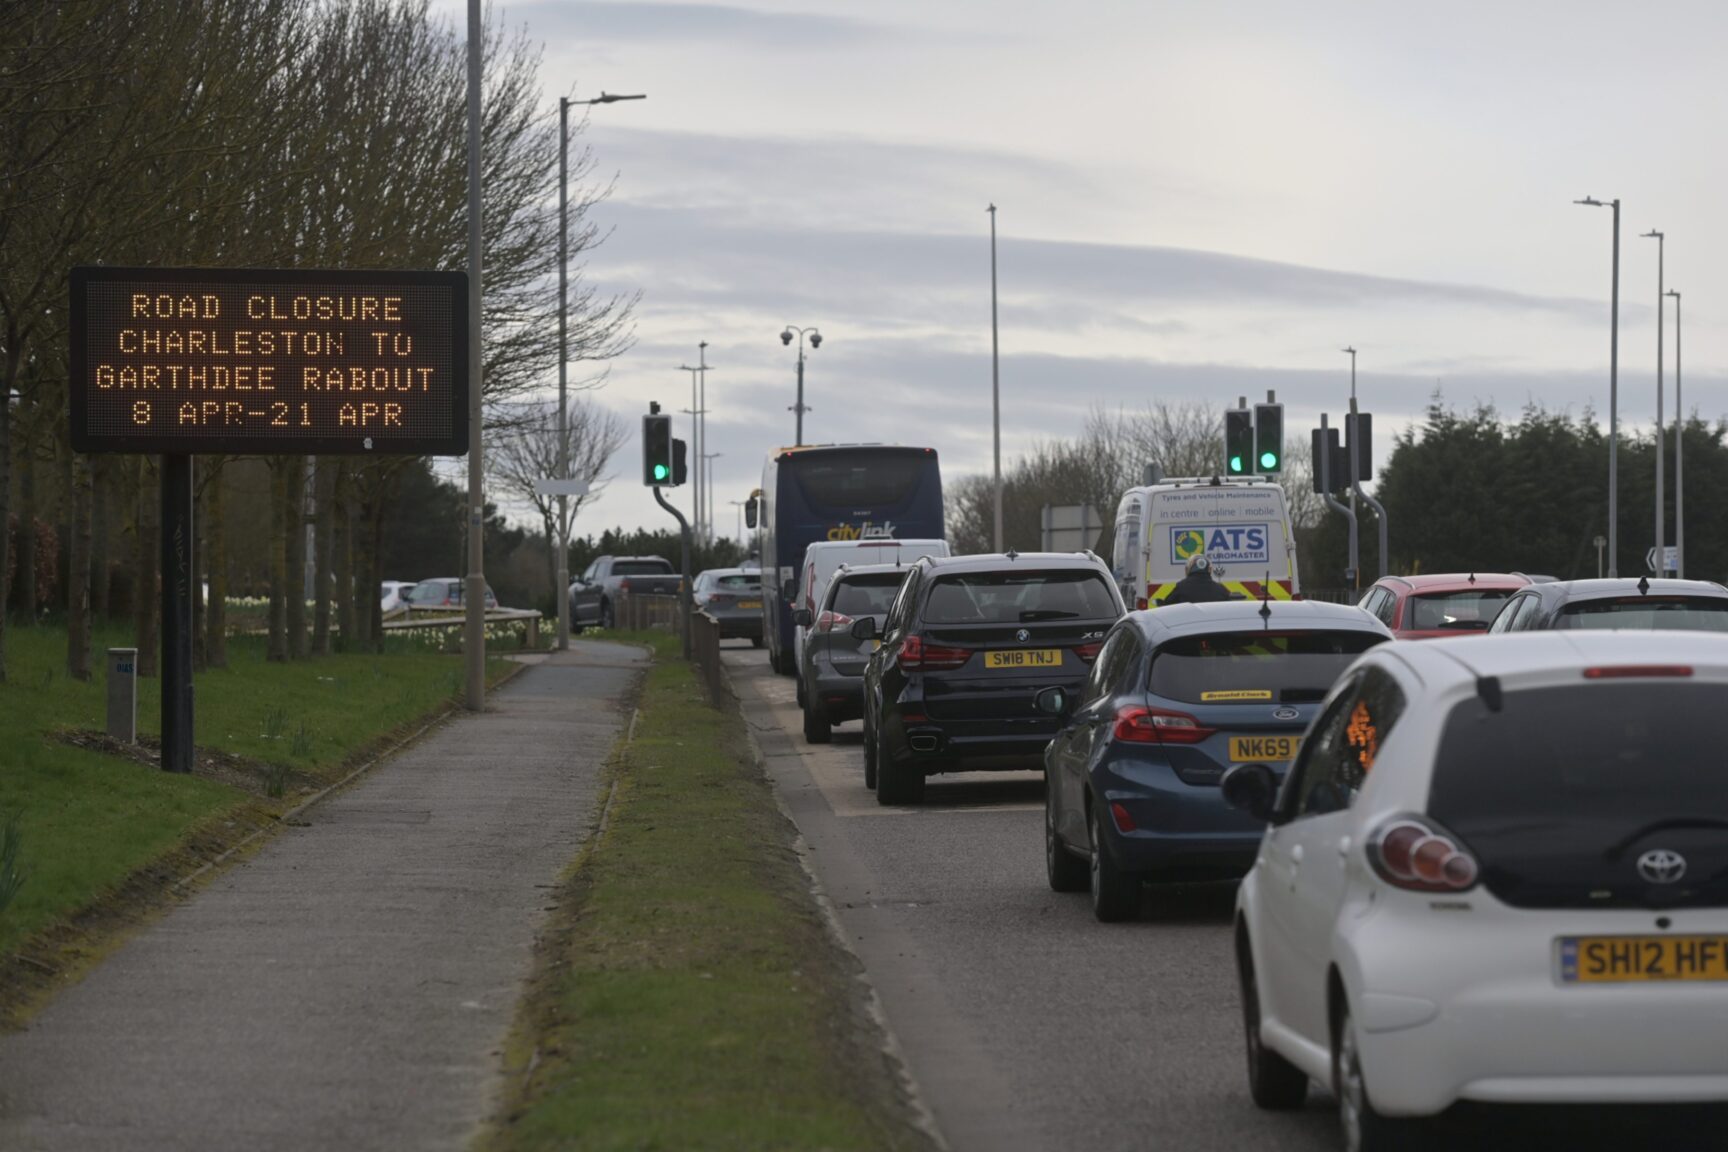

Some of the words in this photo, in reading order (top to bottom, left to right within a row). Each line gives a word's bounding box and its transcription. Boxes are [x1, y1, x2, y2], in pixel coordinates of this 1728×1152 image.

[132, 294, 220, 319] ROAD
[247, 296, 403, 321] CLOSURE
[119, 329, 344, 356] CHARLESTON
[371, 332, 412, 356] TO
[96, 364, 276, 390] GARTHDEE
[303, 367, 434, 391] RABOUT
[132, 400, 151, 424] 8
[179, 401, 311, 426] APR-21
[338, 403, 403, 427] APR
[1162, 494, 1181, 502] Tyres
[1199, 492, 1224, 500] Vehicle
[1160, 510, 1169, 519] in
[1170, 509, 1199, 519] centre
[1208, 507, 1236, 517] online
[1244, 505, 1275, 516] mobile
[827, 520, 896, 540] citylink
[1207, 528, 1264, 551] ATS
[1206, 551, 1265, 560] EUROMASTER
[1081, 631, 1104, 639] X5
[993, 652, 1024, 665] SW18
[1027, 651, 1054, 664] TNJ
[1237, 738, 1290, 757] NK69
[1586, 942, 1664, 974] SH12
